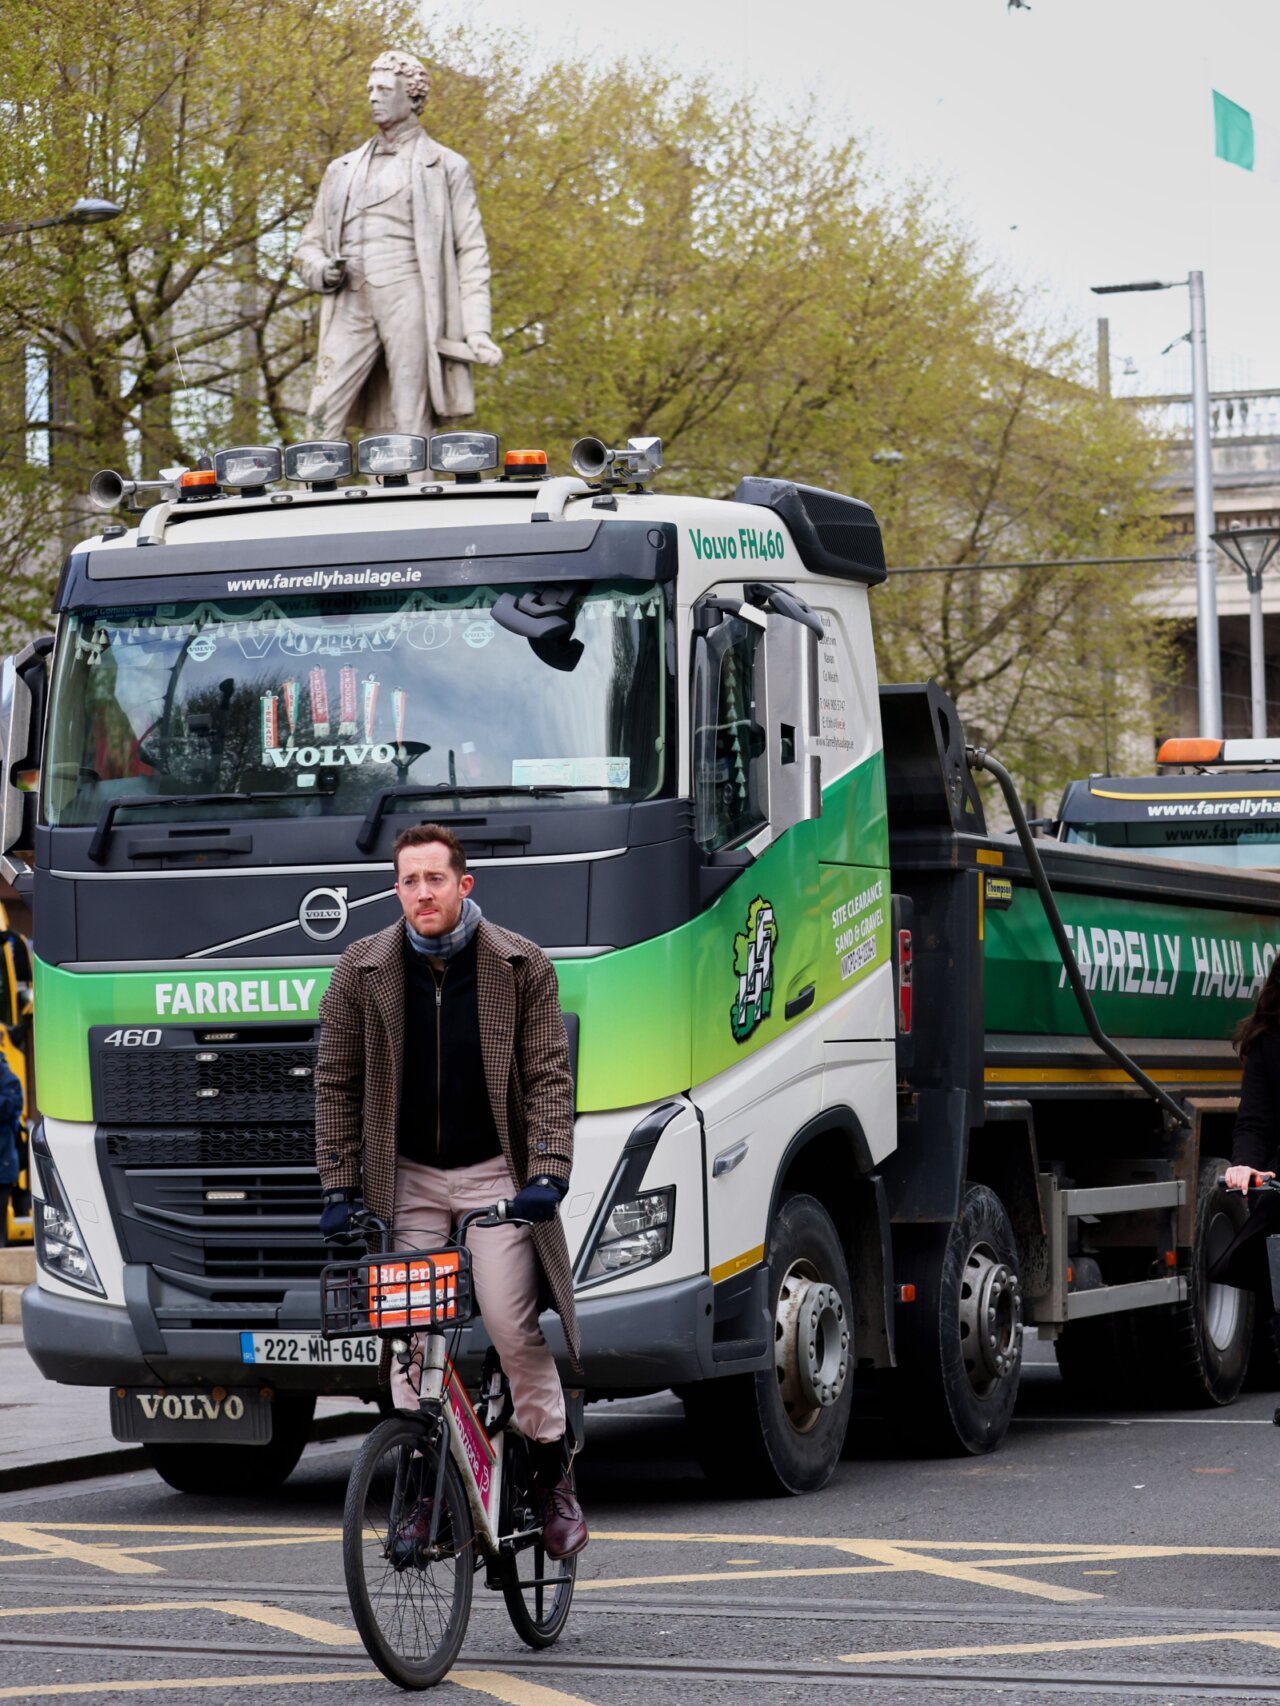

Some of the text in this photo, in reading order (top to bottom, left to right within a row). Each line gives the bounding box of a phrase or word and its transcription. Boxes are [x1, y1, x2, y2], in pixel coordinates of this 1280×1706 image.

[738, 528, 785, 561] FH460
[227, 568, 422, 592] www.farrellyhaulage.ie
[265, 705, 273, 747] IRELAND
[266, 744, 396, 768] VOLVO
[304, 909, 342, 919] VOLVO
[832, 880, 883, 929] SITE CLEARANCE
[835, 908, 884, 955] SAND & GRAVEL
[1058, 924, 1181, 996] FARRELLY
[155, 979, 317, 1015] FARRELLY
[104, 1029, 162, 1046] 460
[264, 1338, 377, 1363] 222-MH-646
[136, 1394, 244, 1420] VOLVO
[453, 1405, 480, 1476] Payzone
